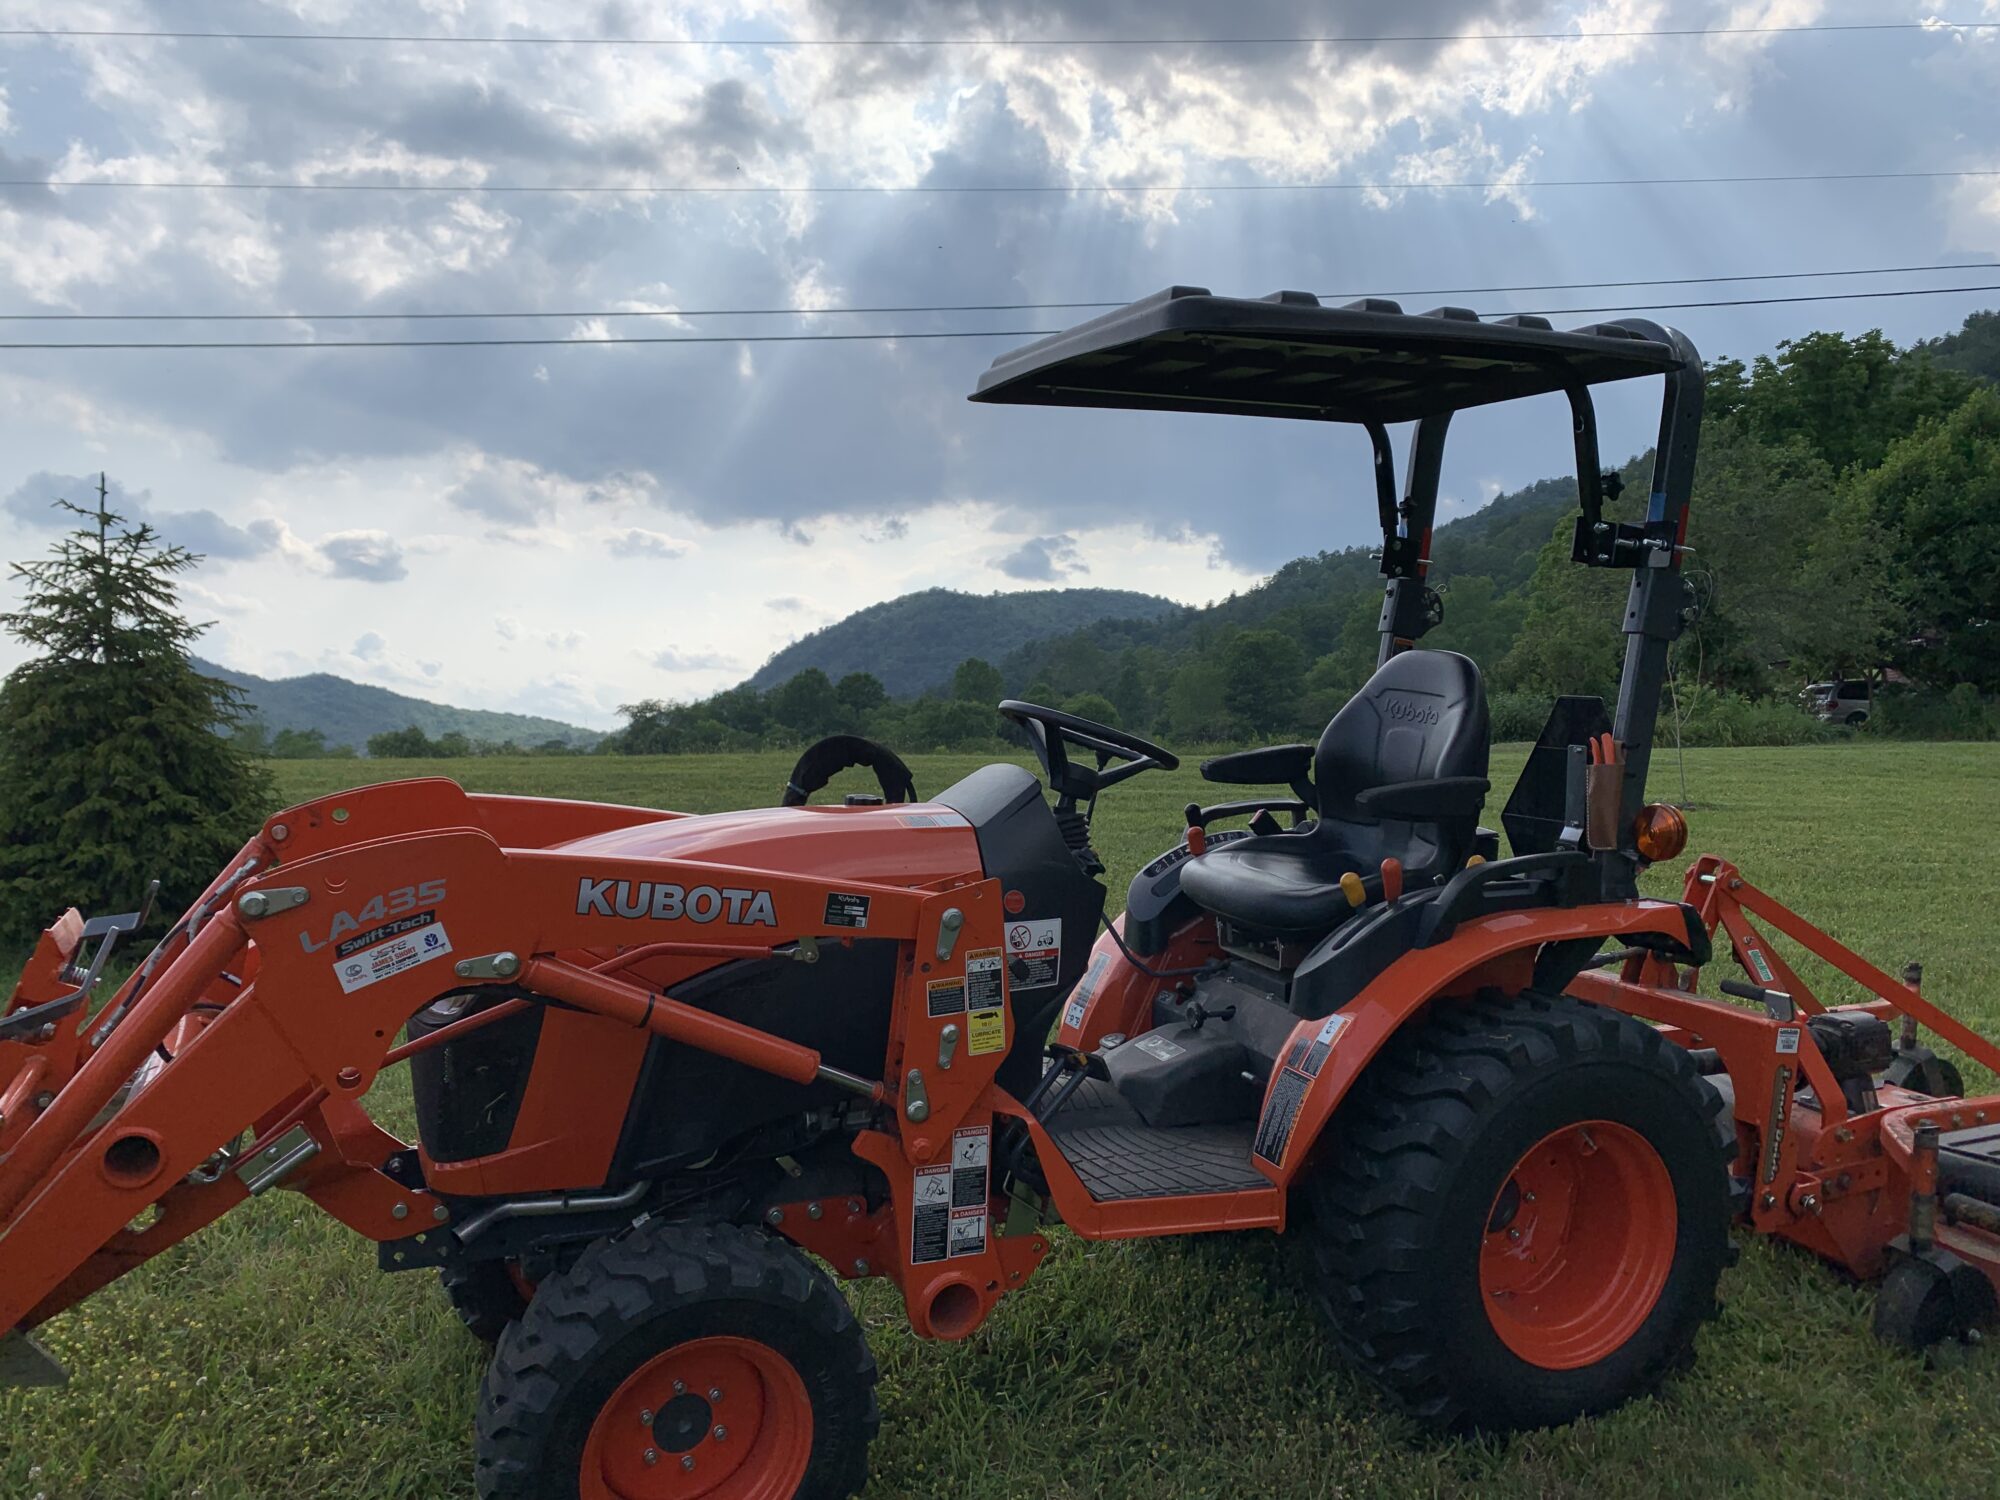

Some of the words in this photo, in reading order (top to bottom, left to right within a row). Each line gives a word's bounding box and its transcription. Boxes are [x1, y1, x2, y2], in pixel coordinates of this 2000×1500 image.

[1384, 698, 1439, 725] Kubota
[576, 877, 778, 927] KUBOTA
[299, 879, 447, 953] LA435
[340, 914, 431, 955] Swift-Tach
[371, 956, 393, 970] JAMES
[394, 946, 417, 960] SHORT
[973, 950, 1000, 958] WARNING
[935, 980, 963, 988] WARNING
[971, 1029, 1001, 1039] LUBRICATE
[962, 1128, 988, 1136] DANGER
[924, 1166, 949, 1174] DANGER
[960, 1208, 985, 1217] DANGER
